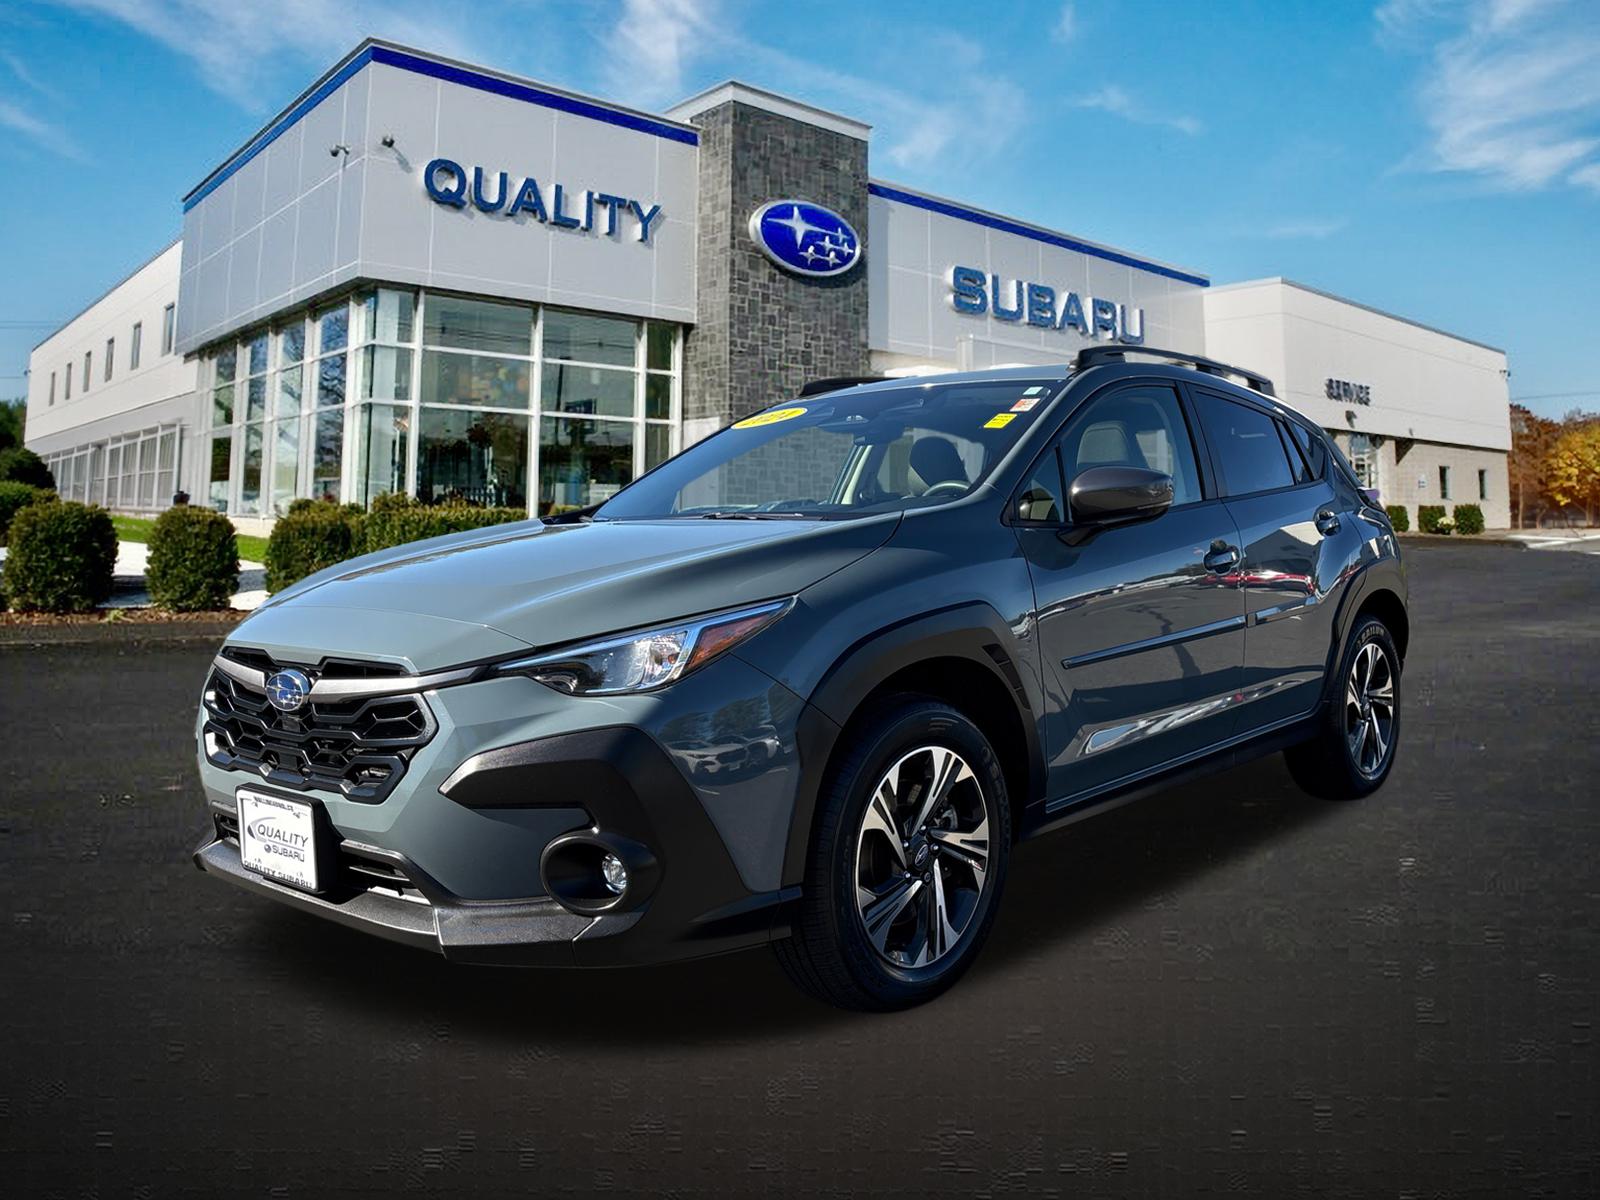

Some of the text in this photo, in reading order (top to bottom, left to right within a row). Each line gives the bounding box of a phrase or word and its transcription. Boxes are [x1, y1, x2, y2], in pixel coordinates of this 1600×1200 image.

[423, 158, 662, 243] QUALITY
[950, 265, 1145, 346] SUBARU
[257, 823, 309, 847] QUALITY
[272, 844, 305, 862] SUBARU
[244, 860, 313, 889] QUALITY SUBARU
